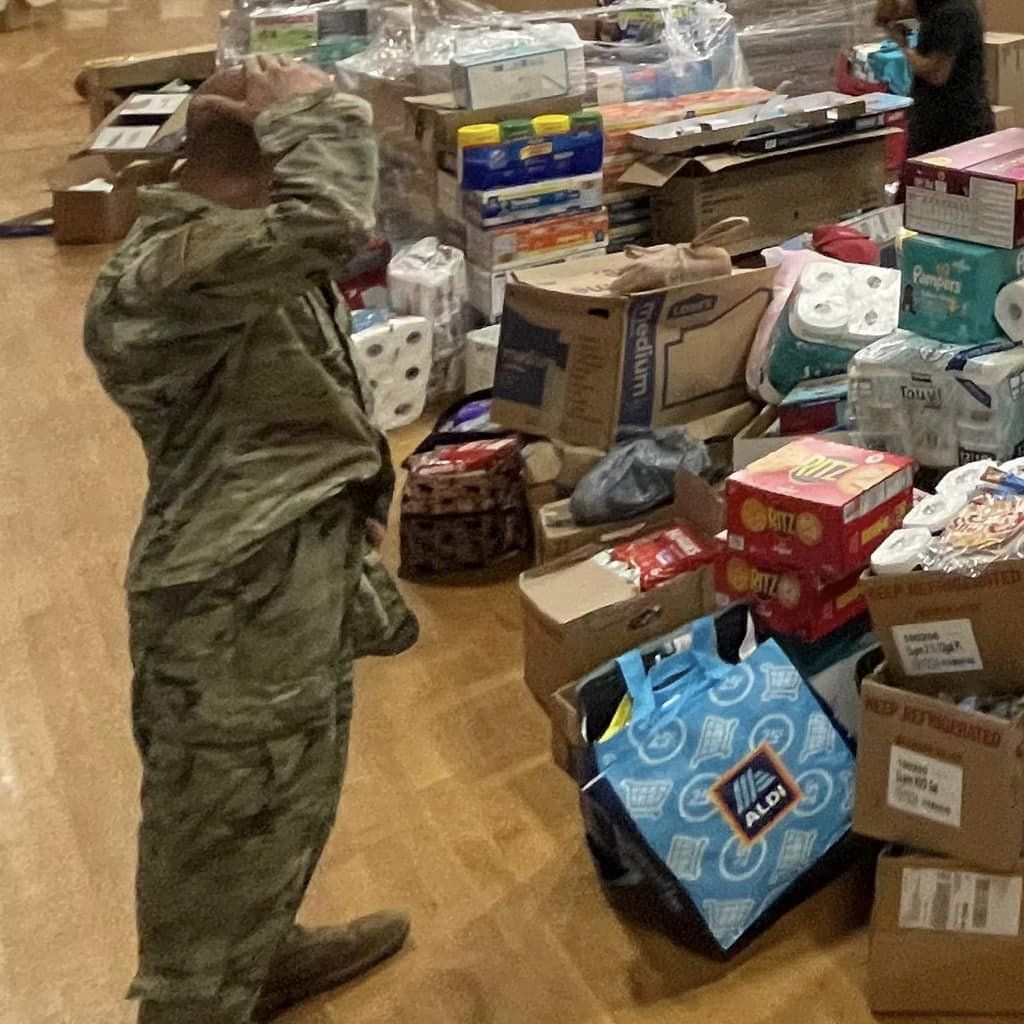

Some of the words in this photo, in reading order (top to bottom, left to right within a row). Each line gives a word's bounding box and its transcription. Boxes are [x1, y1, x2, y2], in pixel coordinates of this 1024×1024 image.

[912, 264, 961, 295] Pampers
[632, 303, 655, 398] medium
[794, 455, 858, 481] RITZ
[768, 508, 796, 535] RITZ
[751, 569, 780, 594] RITZ
[864, 697, 897, 716] KEEP
[899, 704, 1003, 748] REFRIGERATED
[745, 785, 787, 828] ALDI
